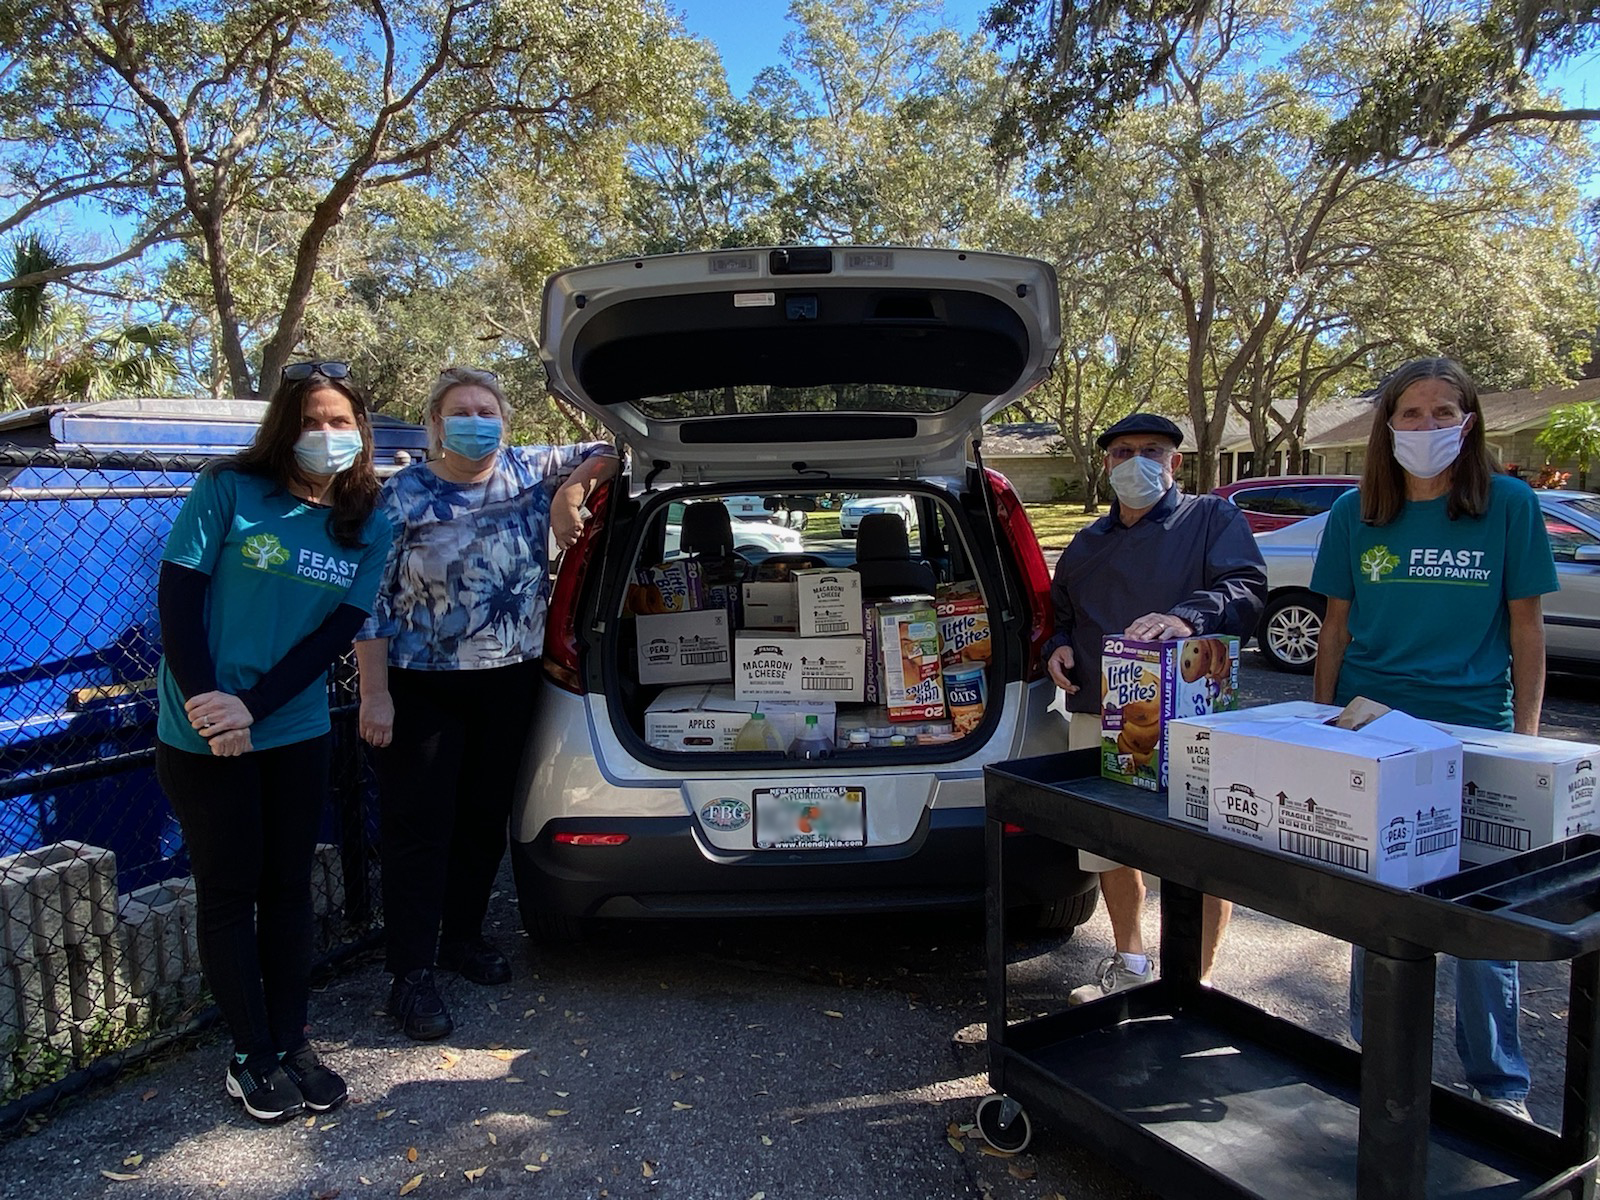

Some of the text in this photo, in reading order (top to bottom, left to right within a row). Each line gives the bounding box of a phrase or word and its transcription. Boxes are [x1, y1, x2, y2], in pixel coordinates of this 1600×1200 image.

[298, 548, 359, 578] FEAST
[1410, 549, 1485, 567] FEAST
[297, 565, 354, 589] FOOD PANT
[687, 562, 698, 578] 20
[1408, 566, 1491, 580] FOOD PANTRY
[662, 568, 687, 596] Little
[812, 586, 844, 594] MACARONI
[656, 580, 676, 609] Bites
[936, 604, 956, 615] 20
[942, 616, 976, 642] Little
[954, 627, 990, 650] Bites
[650, 646, 670, 654] PEAS
[1104, 640, 1124, 654] 20
[742, 660, 792, 671] MACARONI
[754, 670, 788, 680] CHEESE
[1108, 662, 1142, 690] Little
[906, 680, 931, 696] Bites
[916, 686, 940, 704] Little
[1119, 684, 1156, 704] Bites
[950, 690, 977, 703] OATS
[1164, 682, 1172, 718] VALUE
[688, 720, 716, 729] APPLES
[1186, 746, 1209, 755] MACA
[1197, 756, 1209, 765] CHE
[1568, 776, 1596, 793] MACARONI
[1575, 788, 1594, 800] CHEESE
[1228, 796, 1258, 816] PEAS
[1281, 810, 1312, 822] FRAGILE
[1388, 827, 1407, 843] PEAS
[776, 840, 862, 848] www.friendlykia.com
